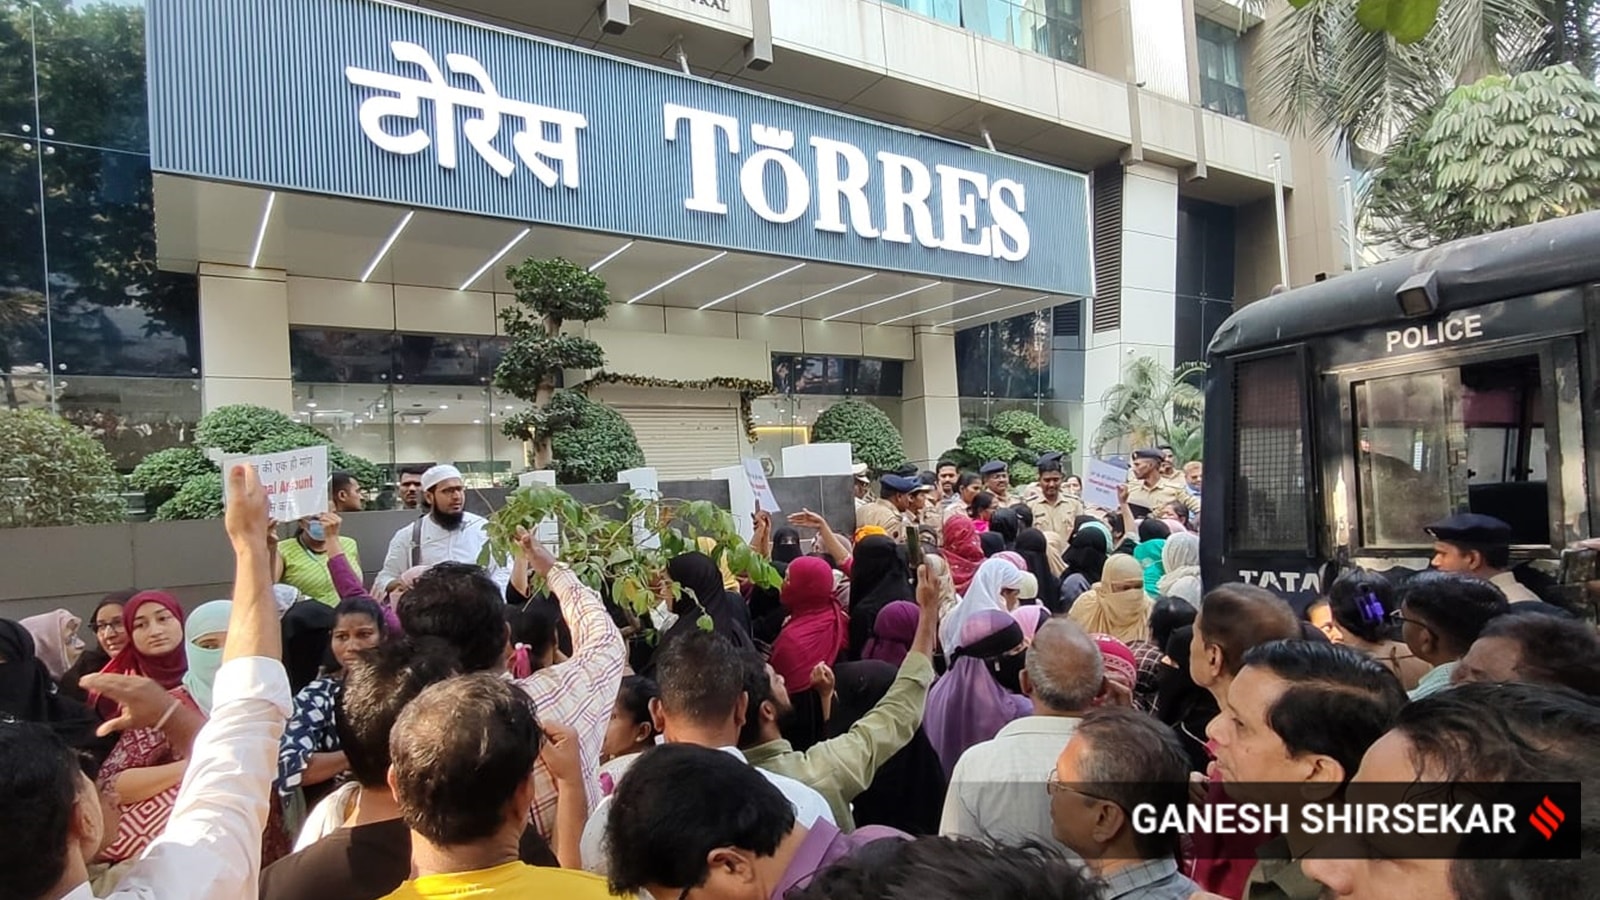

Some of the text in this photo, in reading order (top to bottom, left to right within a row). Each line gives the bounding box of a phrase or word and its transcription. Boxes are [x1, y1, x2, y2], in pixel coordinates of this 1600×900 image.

[345, 40, 587, 189] टोरेस
[1386, 314, 1483, 352] POLICE
[1238, 569, 1320, 594] TATA
